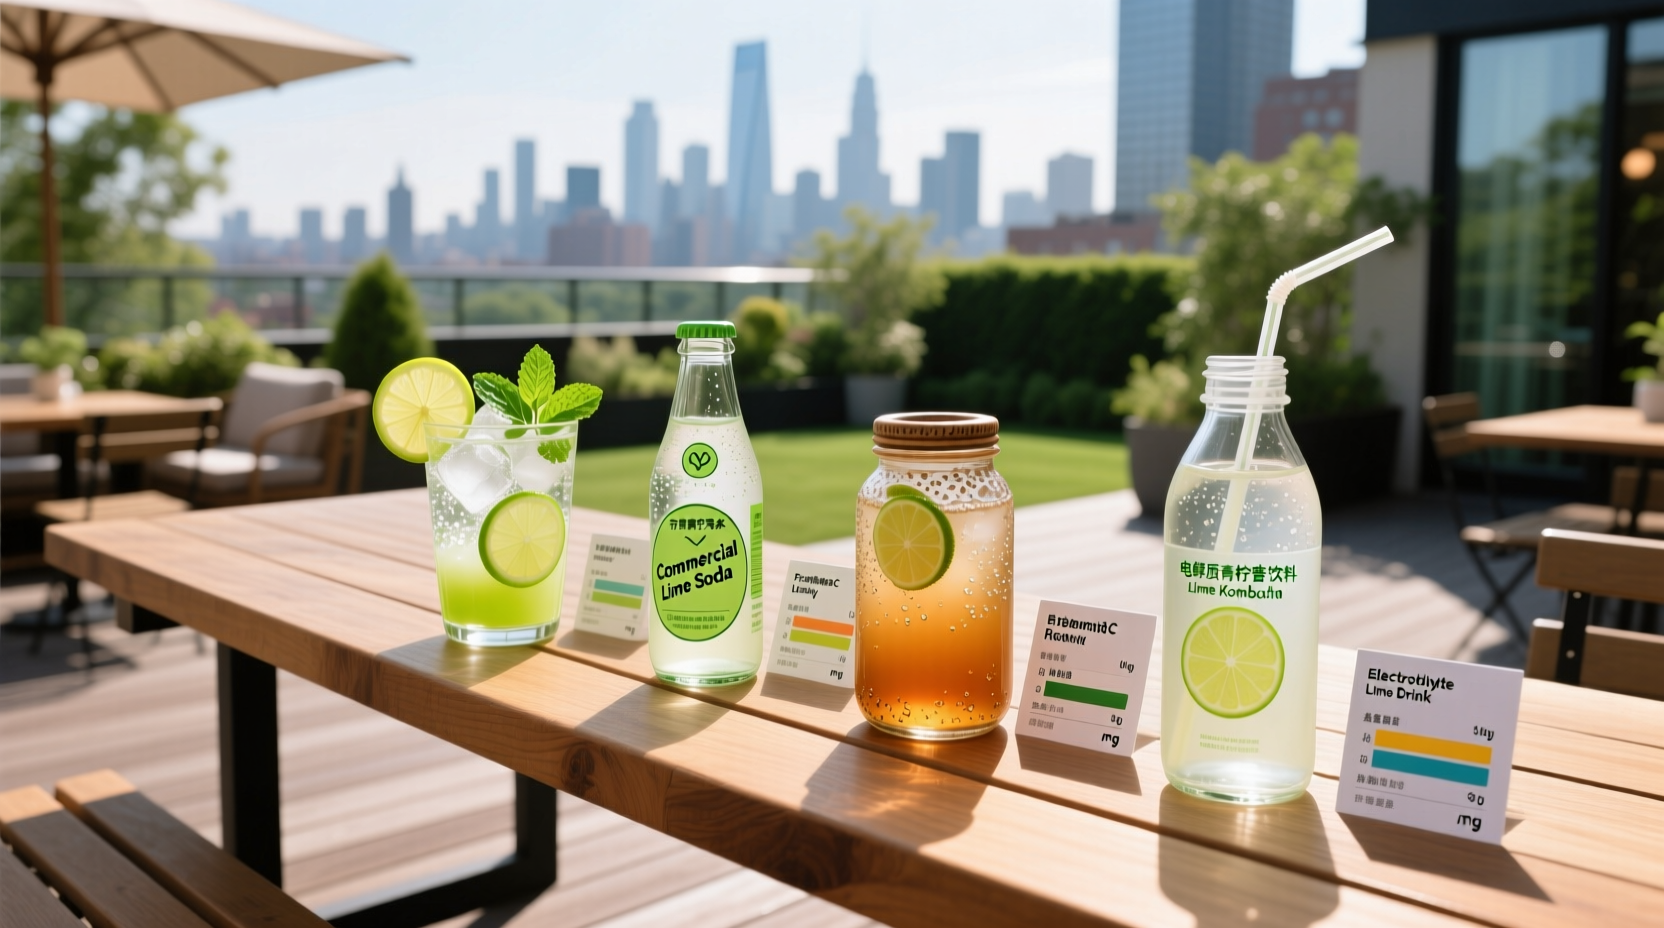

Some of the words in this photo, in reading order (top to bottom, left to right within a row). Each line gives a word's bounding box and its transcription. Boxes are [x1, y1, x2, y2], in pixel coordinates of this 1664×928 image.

[656, 539, 738, 580] Commercial
[661, 581, 691, 601] Lime
[694, 565, 733, 589] Soda
[1365, 683, 1393, 698] Lime
[1396, 687, 1432, 704] Drink
[1101, 732, 1120, 748] mg
[1456, 814, 1482, 832] mg
